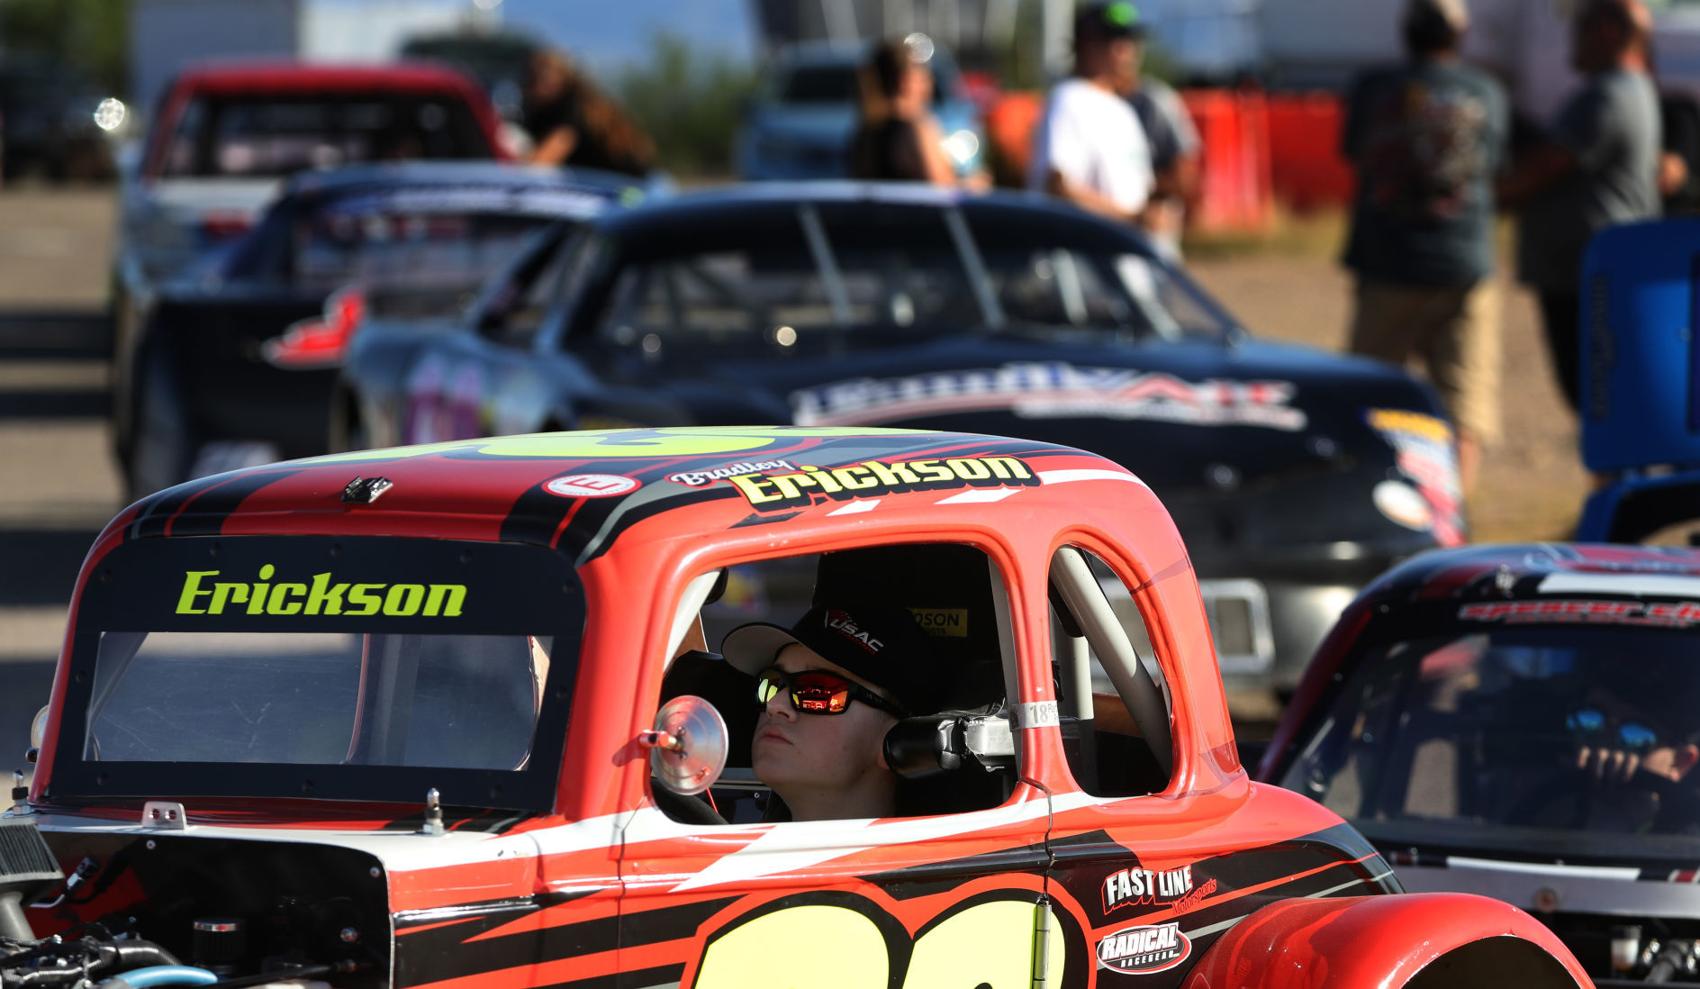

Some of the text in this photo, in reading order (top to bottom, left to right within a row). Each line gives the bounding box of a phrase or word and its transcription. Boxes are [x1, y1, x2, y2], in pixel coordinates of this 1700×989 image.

[670, 457, 1033, 505] Bradley Erickson
[175, 564, 467, 617] Erickson
[830, 618, 884, 652] USAC
[1106, 864, 1193, 906] FAST LINE
[1102, 924, 1177, 961] RADICAL
[1120, 950, 1180, 968] RACEGEAR
